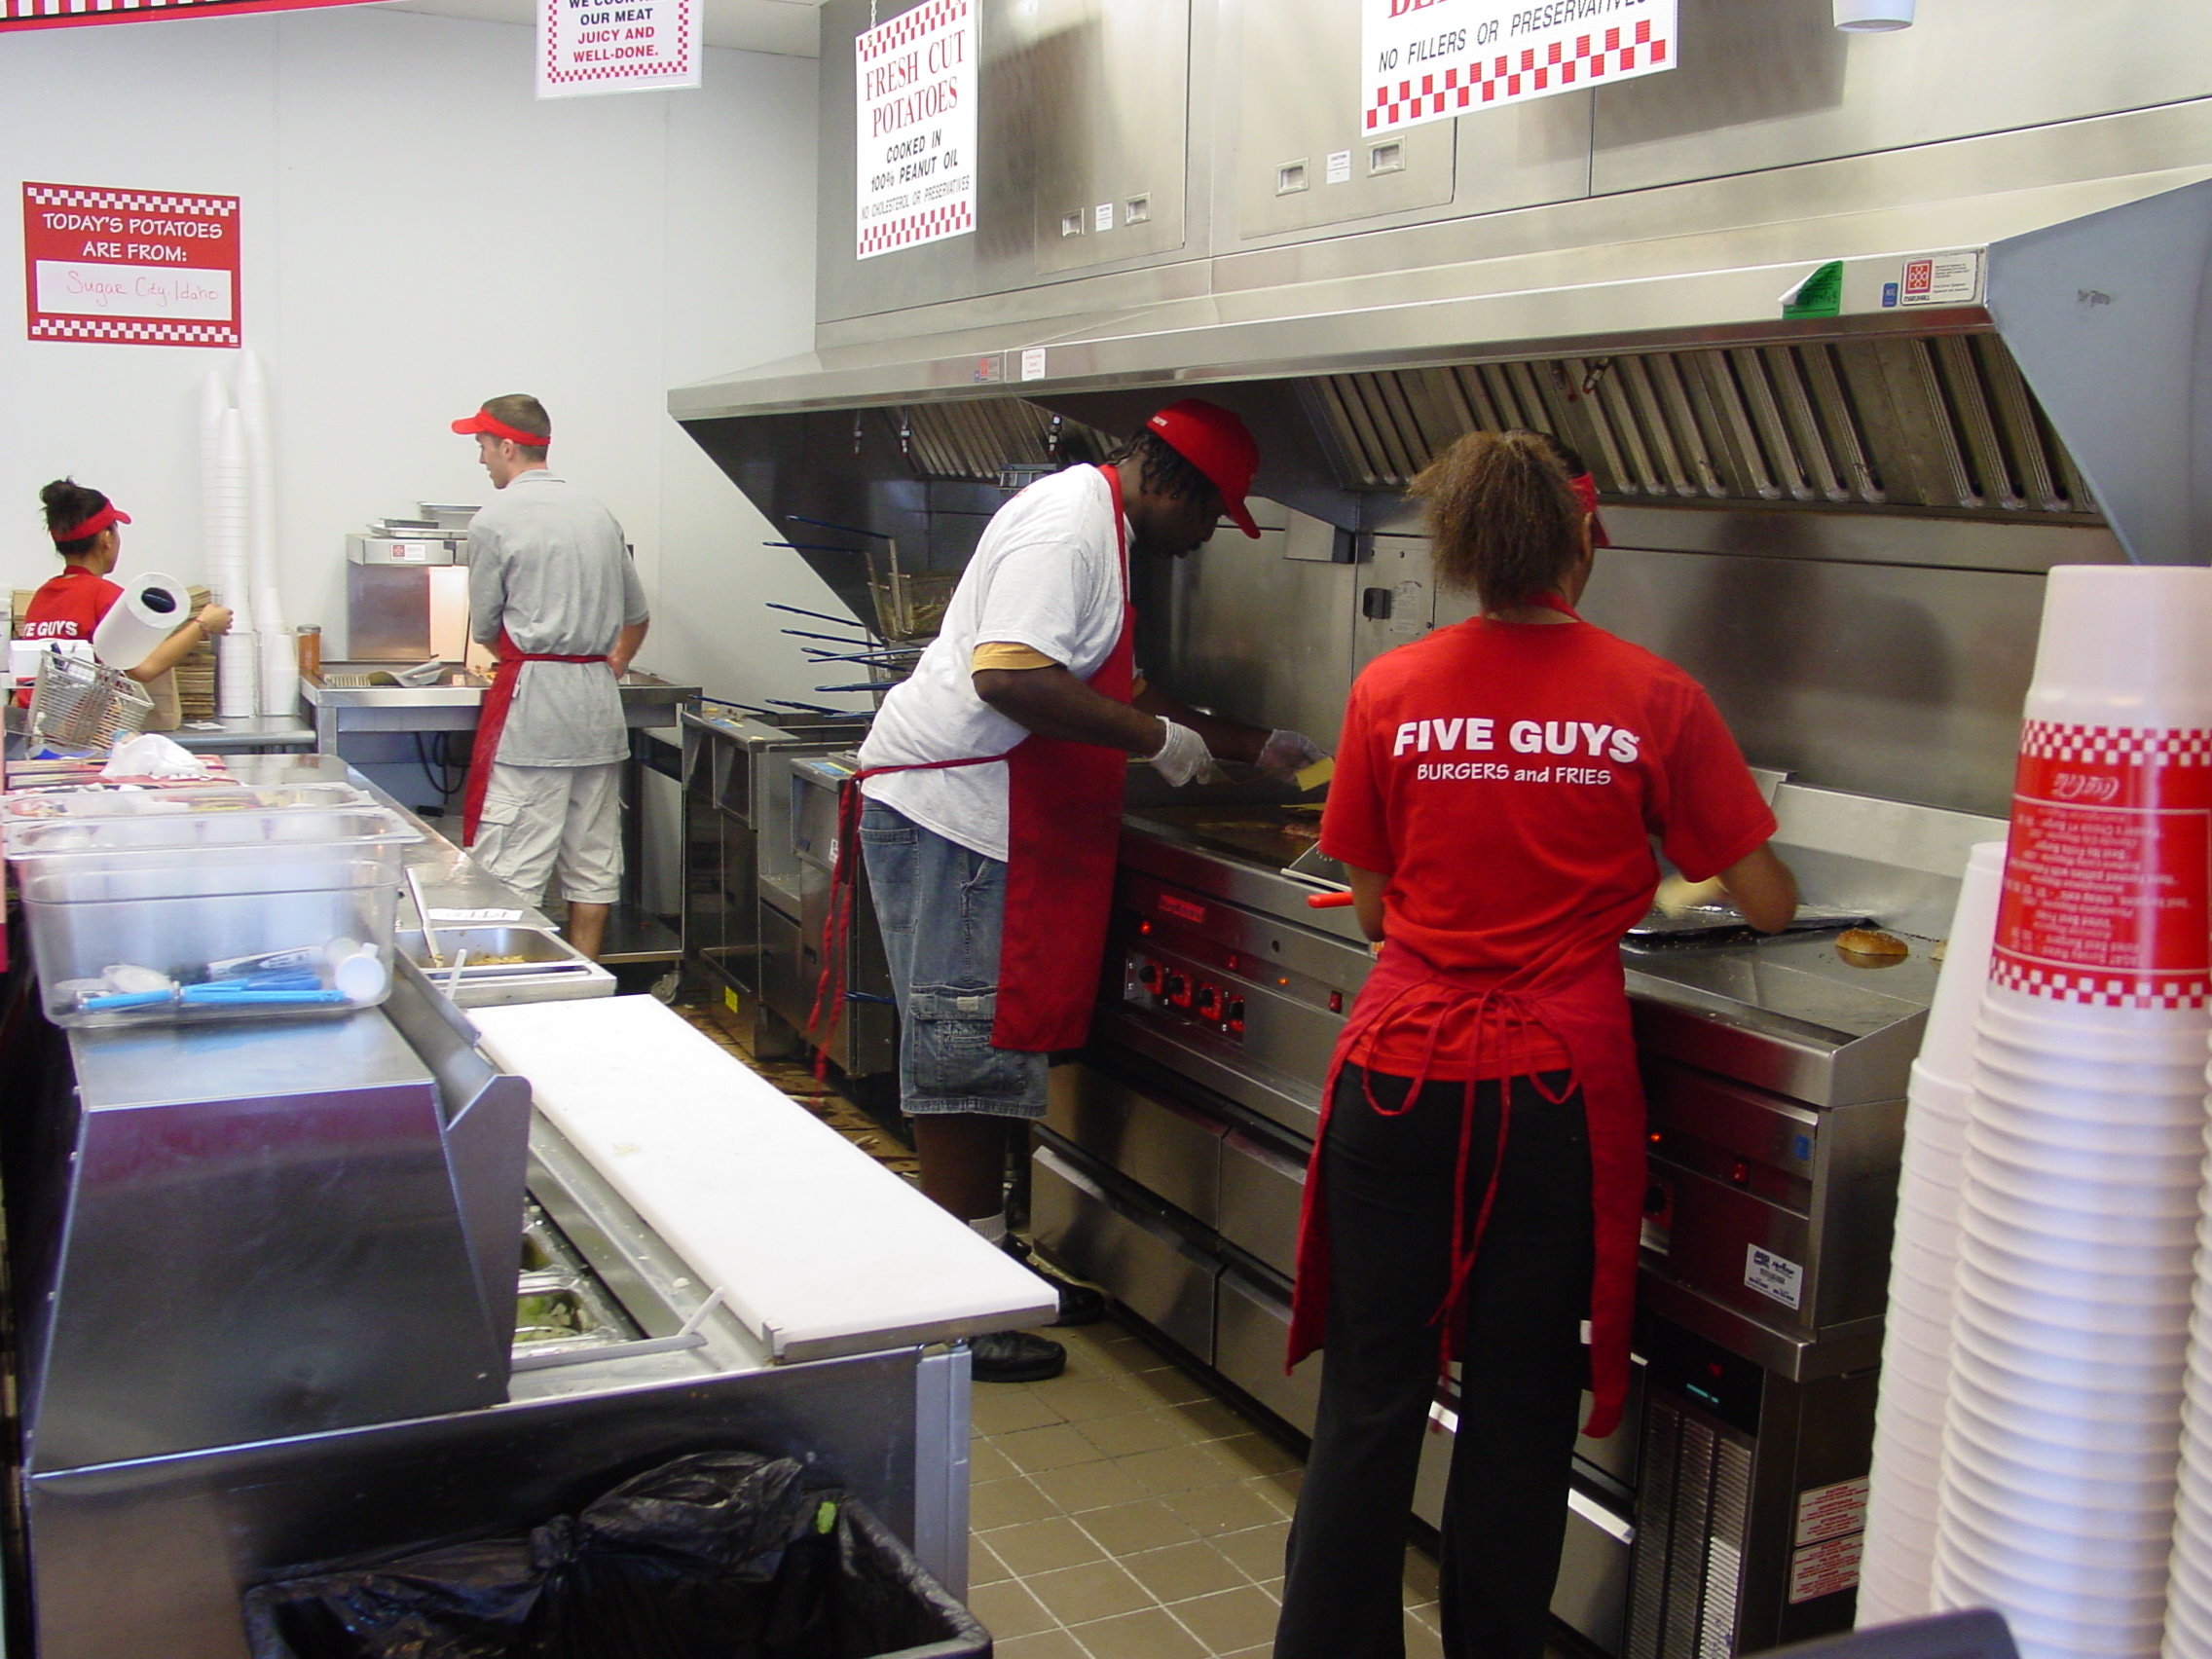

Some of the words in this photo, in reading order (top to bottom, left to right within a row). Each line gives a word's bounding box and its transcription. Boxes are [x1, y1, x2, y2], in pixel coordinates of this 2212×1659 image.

[580, 13, 609, 25] OUR
[614, 8, 653, 22] MEAT
[577, 29, 620, 44] JUICY
[625, 26, 655, 40] AND
[1379, 48, 1398, 73] NO
[1408, 28, 1466, 65] FILLERS
[1477, 19, 1499, 45] OR
[573, 45, 659, 62] WELL-DONE.
[866, 51, 919, 101] FRESH
[928, 29, 966, 74] CUT
[872, 76, 958, 138] POTATOES
[886, 135, 926, 164] COOKED
[932, 129, 942, 149] IN
[871, 169, 895, 193] 100%
[899, 156, 938, 184] PEANUT
[943, 148, 958, 169] OIL
[43, 213, 123, 233] TODAY'S
[129, 218, 223, 239] POTATOES
[83, 240, 122, 258] ARE
[128, 243, 187, 262] FROM:
[37, 620, 78, 637] GUYS
[1393, 718, 1493, 756] FIVE
[1509, 720, 1639, 763] GUYS
[1417, 763, 1509, 781] BURGERS
[1514, 766, 1550, 783] and
[1556, 767, 1611, 785] FRIES
